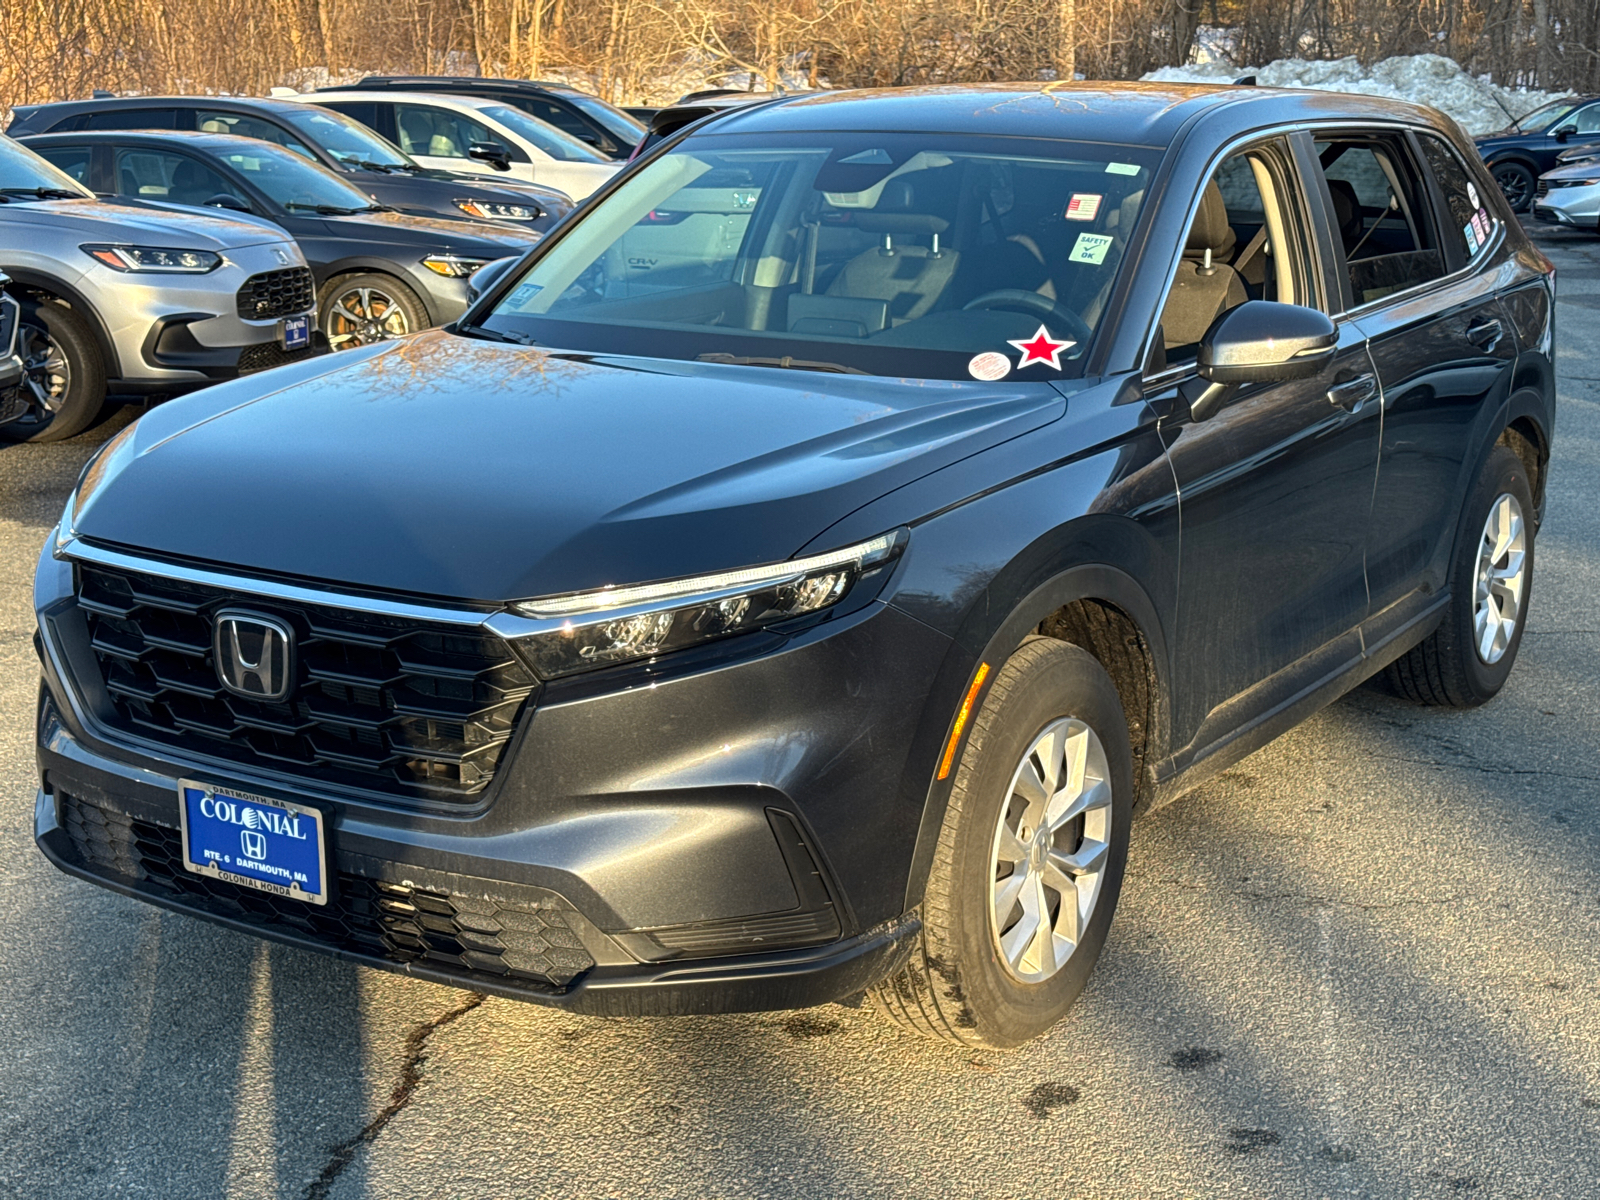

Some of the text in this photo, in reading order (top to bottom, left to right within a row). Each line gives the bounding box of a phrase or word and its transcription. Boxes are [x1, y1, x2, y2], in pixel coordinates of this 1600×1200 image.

[1081, 236, 1109, 245] SAFETY
[1081, 252, 1095, 260] OK
[272, 799, 286, 808] MA
[200, 797, 306, 840] COLONIAL
[204, 849, 308, 882] RTE. 6 DARTMOUTH, MA
[218, 871, 291, 896] COLONIAL HONDA
